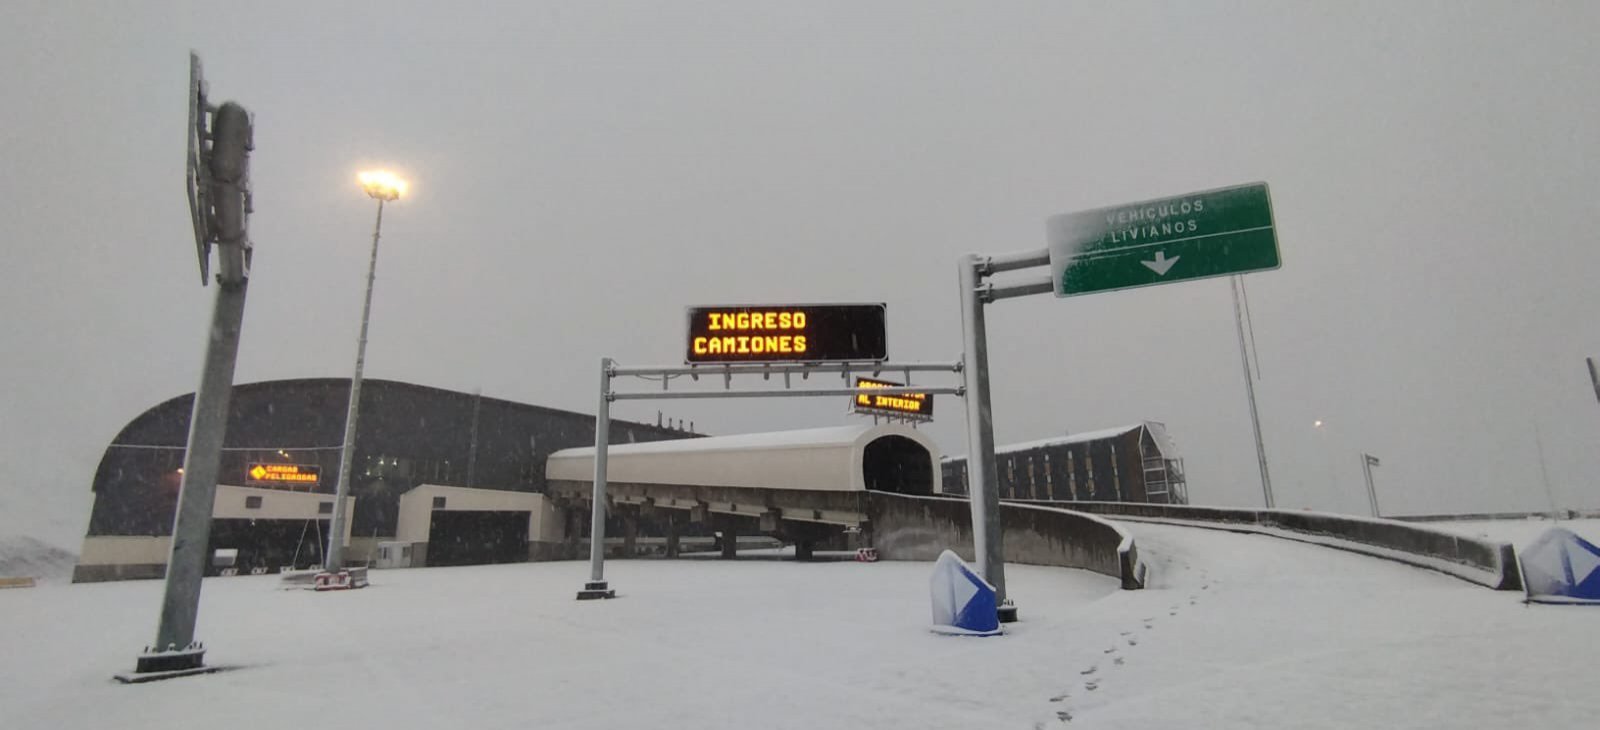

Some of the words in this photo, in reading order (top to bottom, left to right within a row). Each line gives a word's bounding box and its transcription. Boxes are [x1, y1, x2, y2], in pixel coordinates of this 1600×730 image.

[1106, 200, 1204, 225] VEHICULOS
[1111, 219, 1197, 243] LIVIANOS
[708, 312, 806, 330] INGRESO
[694, 336, 806, 354] CAMIONES
[858, 394, 870, 404] AL
[877, 396, 920, 410] INTERIOR
[266, 465, 298, 473] CARGAS
